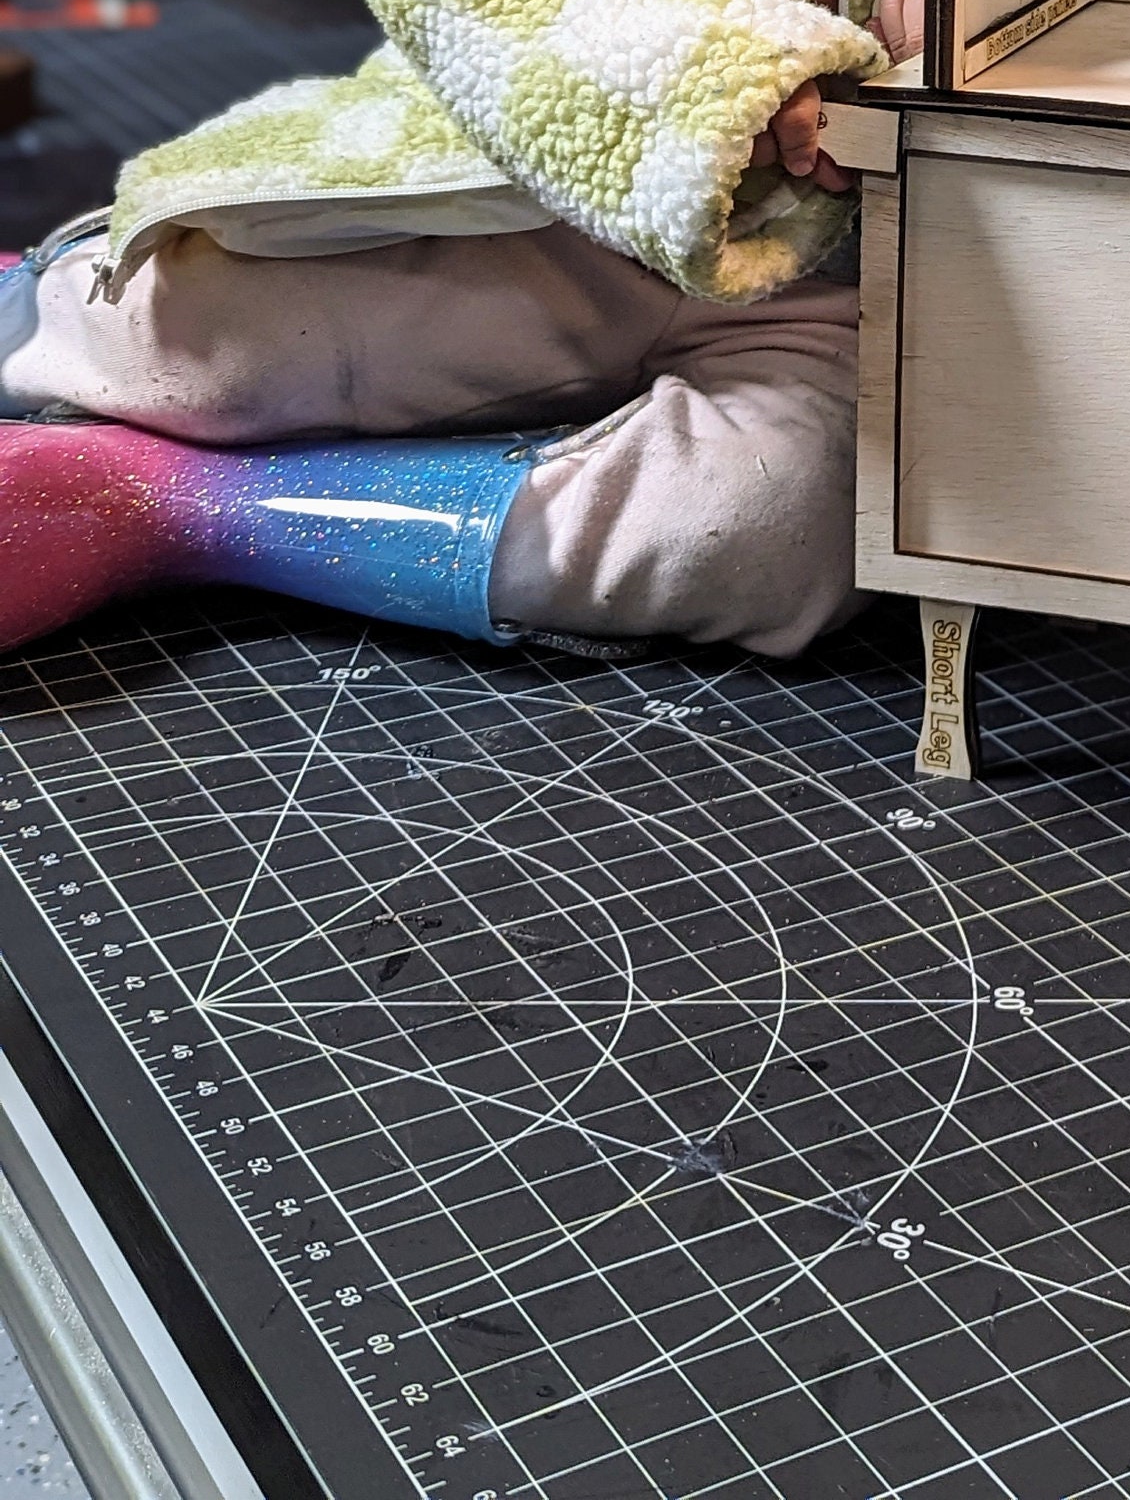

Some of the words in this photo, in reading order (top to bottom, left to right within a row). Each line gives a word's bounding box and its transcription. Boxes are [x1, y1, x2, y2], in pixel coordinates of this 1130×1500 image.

[986, 23, 1025, 61] Bottom
[1025, 7, 1047, 36] side
[931, 619, 962, 705] Short
[318, 664, 382, 681] 150°
[642, 699, 704, 719] 120°
[922, 712, 960, 770] Leg
[886, 807, 936, 831] 90°
[19, 825, 41, 839] 32
[38, 852, 61, 867] 34
[58, 881, 81, 896] 36
[79, 911, 101, 926] 38
[101, 943, 124, 958] 40
[124, 975, 146, 991] 42
[994, 986, 1034, 1016] 60°
[147, 1009, 170, 1024] 44
[171, 1044, 194, 1060] 46
[196, 1080, 219, 1097] 48
[220, 1117, 245, 1135] 50
[247, 1157, 273, 1176] 52
[275, 1198, 302, 1217] 54
[877, 1218, 926, 1260] 30°
[304, 1241, 331, 1261] 56
[335, 1286, 362, 1307] 58
[367, 1333, 395, 1355] 60
[400, 1383, 429, 1407] 62
[435, 1435, 466, 1458] 64
